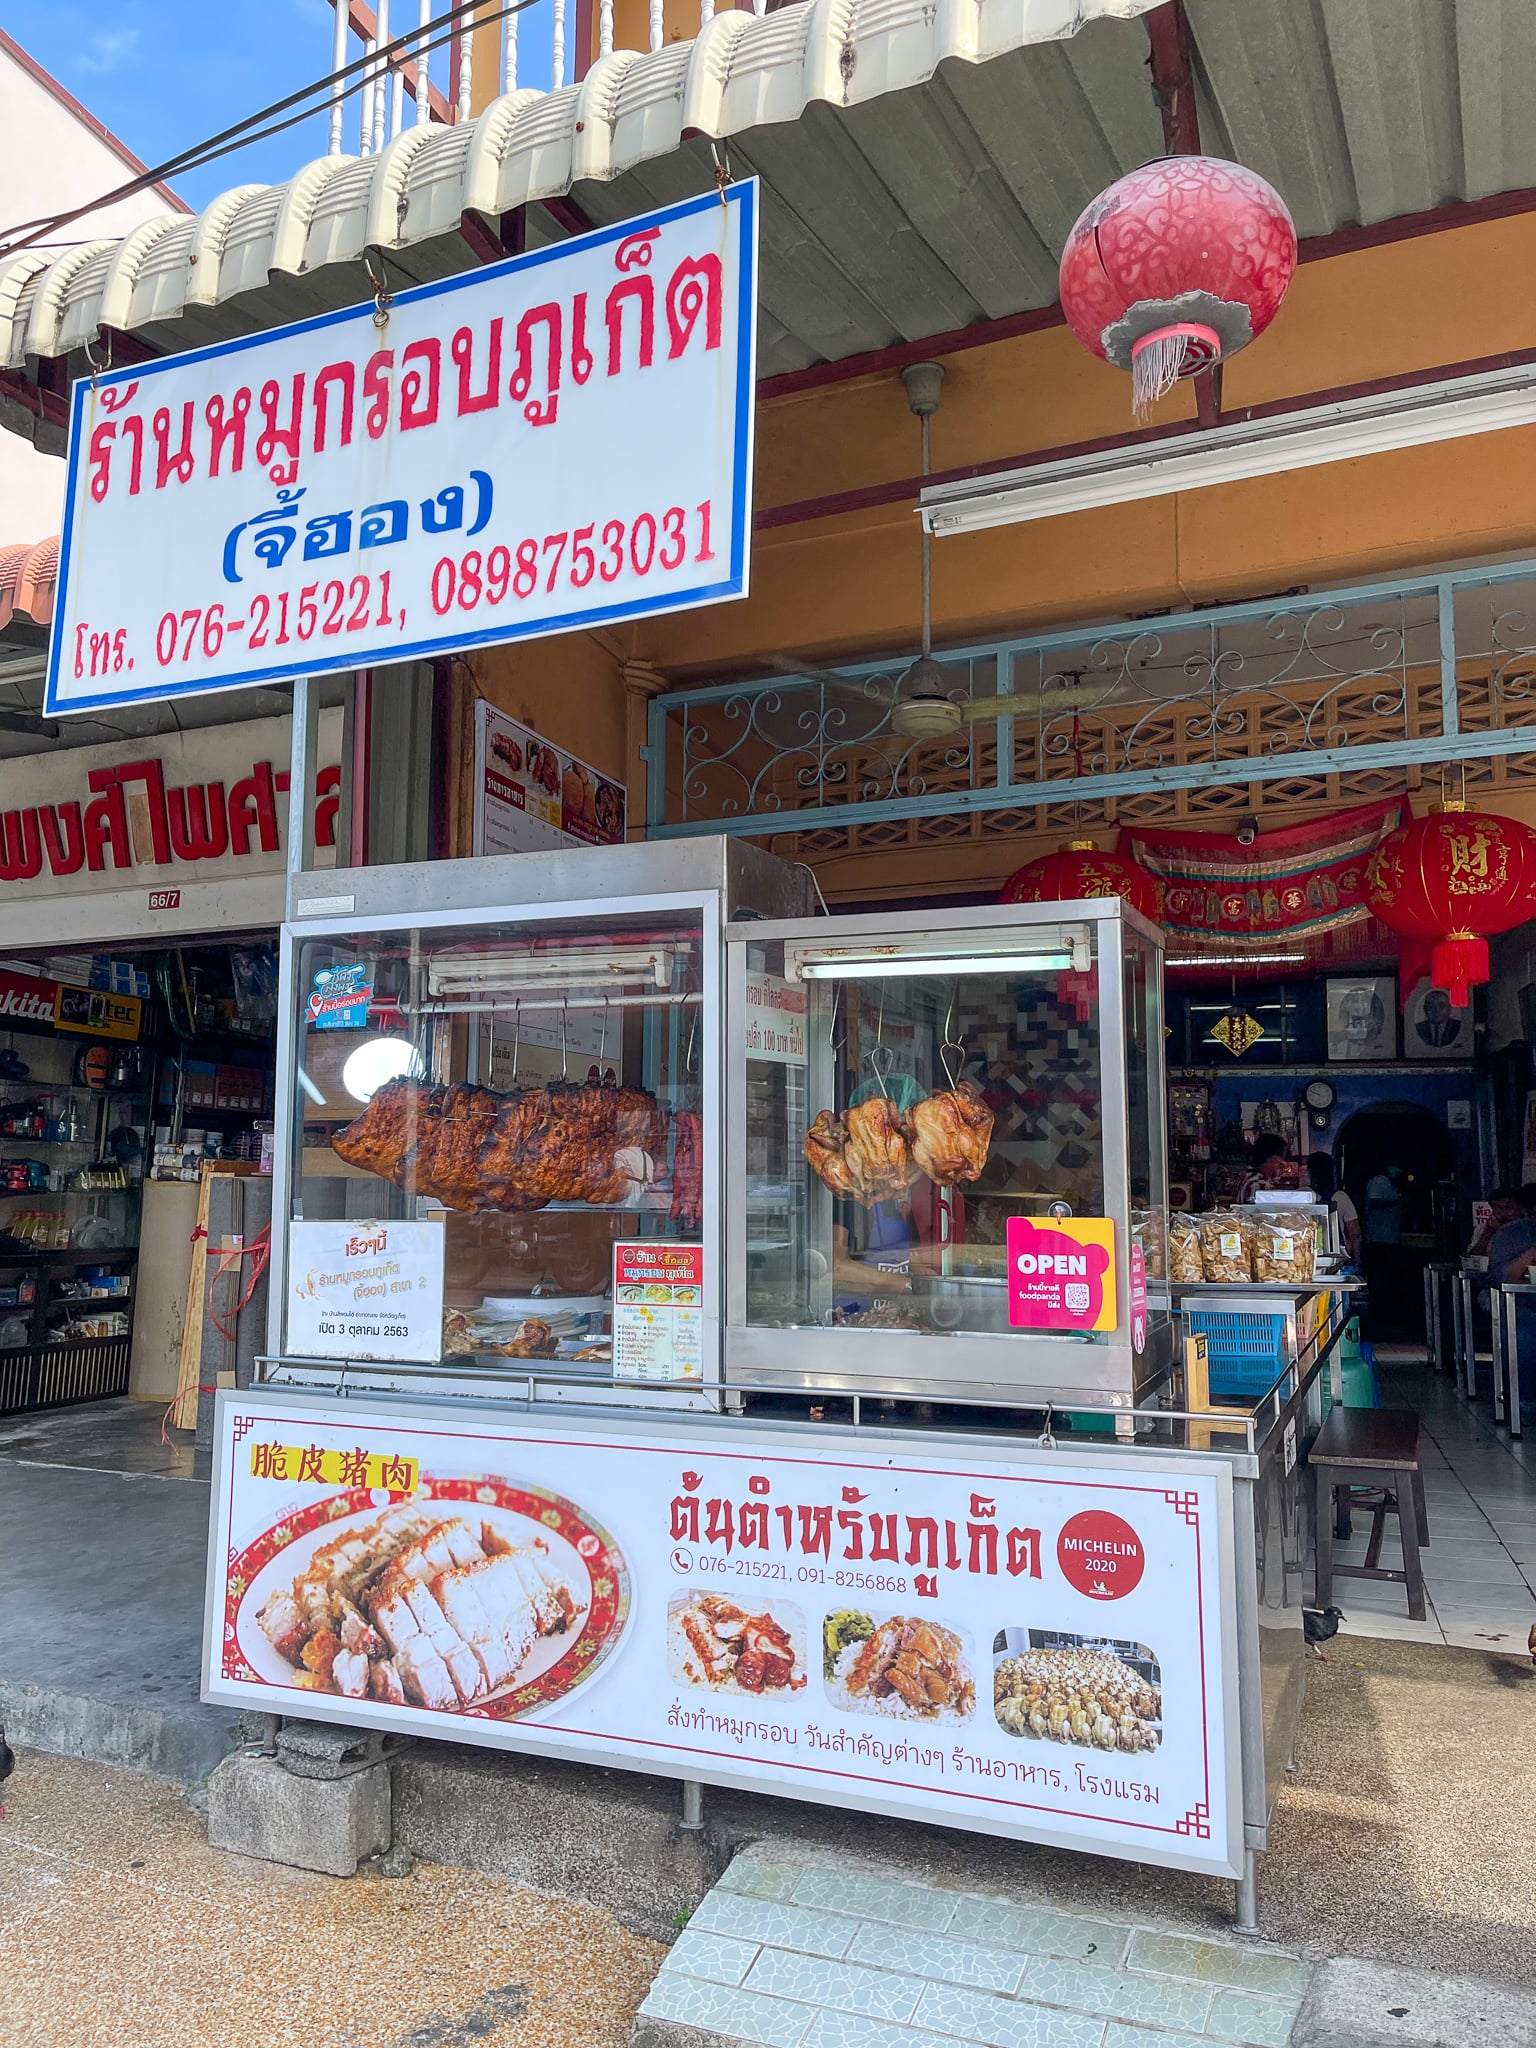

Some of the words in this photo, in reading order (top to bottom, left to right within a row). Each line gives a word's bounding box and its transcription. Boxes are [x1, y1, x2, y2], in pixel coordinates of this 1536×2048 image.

[88, 227, 724, 504] ร้านหมูกรอบภูเก็ต
[222, 470, 495, 584] (จี้ฮอง)
[74, 622, 136, 680] โทร.
[156, 570, 407, 667] 076-215221,
[431, 500, 716, 617] 0898753031
[150, 893, 178, 908] 66/7
[763, 1029, 776, 1052] 100
[345, 1230, 388, 1257] เร็วๆนี้
[319, 1260, 401, 1286] ร้านหมูกรอบภูเก็ต
[1017, 1253, 1087, 1276] OPEN
[353, 1283, 387, 1302] (จี้ฮอง)
[390, 1279, 412, 1293] สาขา
[418, 1276, 427, 1289] 2
[1019, 1290, 1061, 1302] foodpanda
[318, 1322, 335, 1334] เปิด
[338, 1323, 345, 1334] 3
[348, 1325, 380, 1338] ตุลาคม
[383, 1325, 409, 1337] 2563
[252, 1440, 413, 1491] 脆皮猪肉
[1064, 1537, 1137, 1557] MICHELIN
[698, 1555, 793, 1582] 076-215221,
[797, 1566, 908, 1593] 091-8256868
[1084, 1558, 1117, 1573] 2020
[666, 1696, 798, 1745] สั่งทำหมูกรอบ
[804, 1724, 945, 1774] วันสำคัญต่างๆ
[951, 1746, 1068, 1792] ร้านอาหาร,
[1074, 1763, 1160, 1804] โรงแรม
